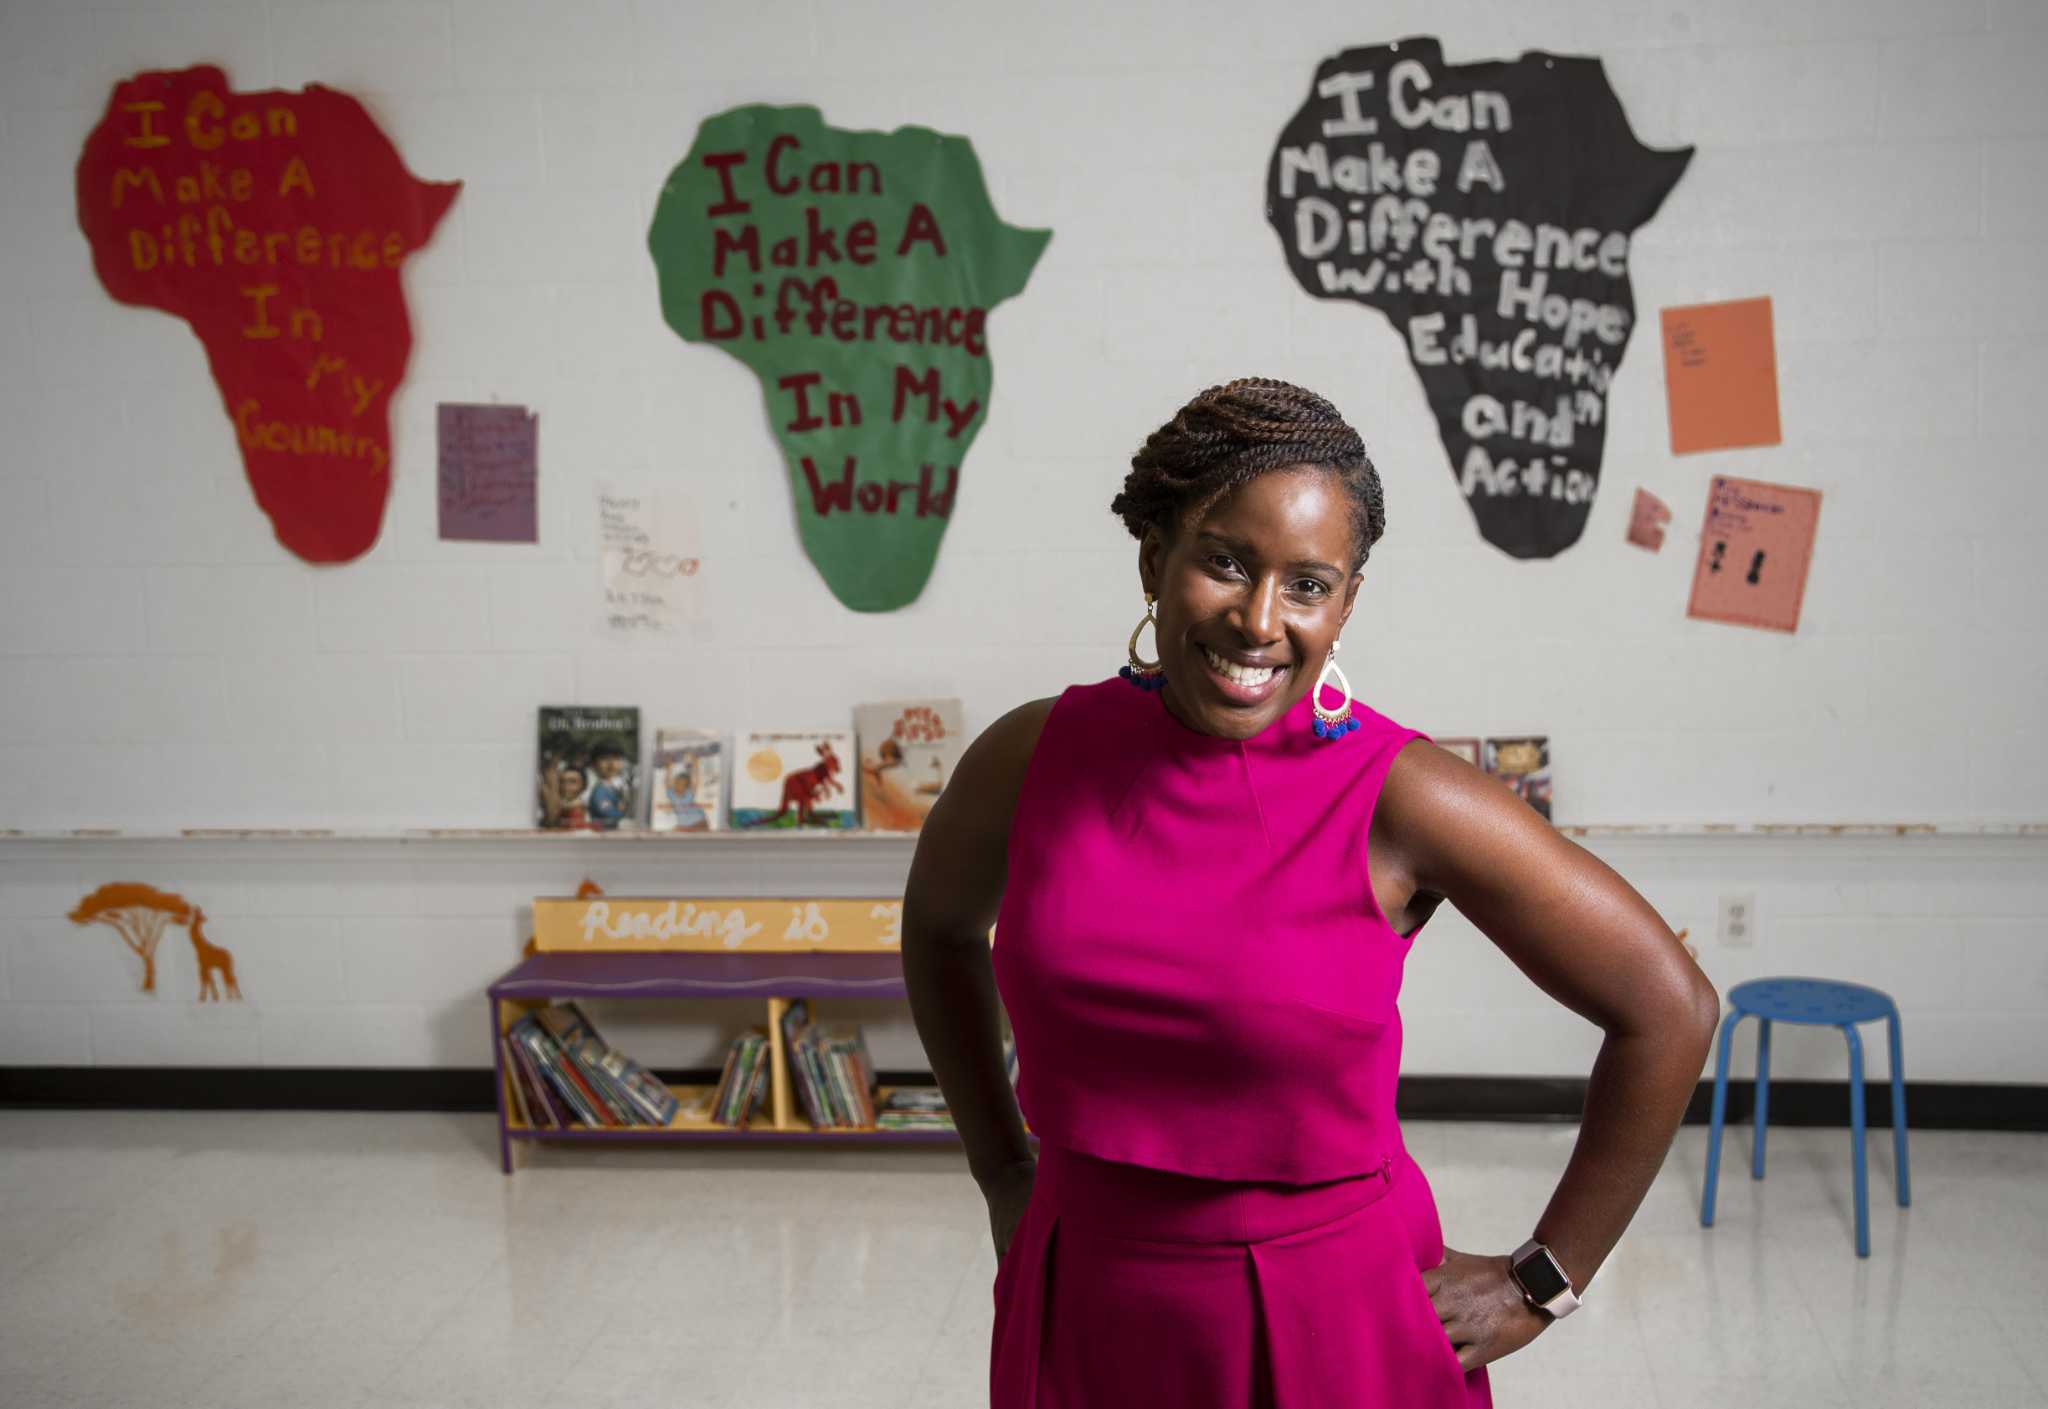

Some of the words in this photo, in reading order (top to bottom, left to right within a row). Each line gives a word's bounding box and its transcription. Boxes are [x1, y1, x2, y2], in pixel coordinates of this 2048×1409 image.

[123, 100, 170, 148] I
[185, 90, 298, 150] Can
[1318, 70, 1378, 138] I
[1387, 59, 1512, 133] Can
[112, 160, 254, 208] Make
[279, 157, 316, 197] A
[703, 150, 751, 218] I
[764, 133, 882, 196] Can
[1279, 142, 1441, 198] Make
[1457, 140, 1506, 193] A
[130, 205, 402, 271] Difference
[714, 207, 878, 278] Make
[896, 202, 947, 258] A
[1295, 196, 1630, 276] Difference
[240, 284, 323, 342] In
[700, 277, 987, 357] Difference
[1318, 248, 1471, 296] With
[1497, 270, 1630, 347] Hope
[306, 352, 383, 417] My
[778, 372, 861, 433] In
[892, 364, 980, 438] My
[800, 455, 960, 519] World
[1461, 445, 1597, 505] Action
[579, 901, 762, 948] Reading
[784, 902, 829, 942] is
